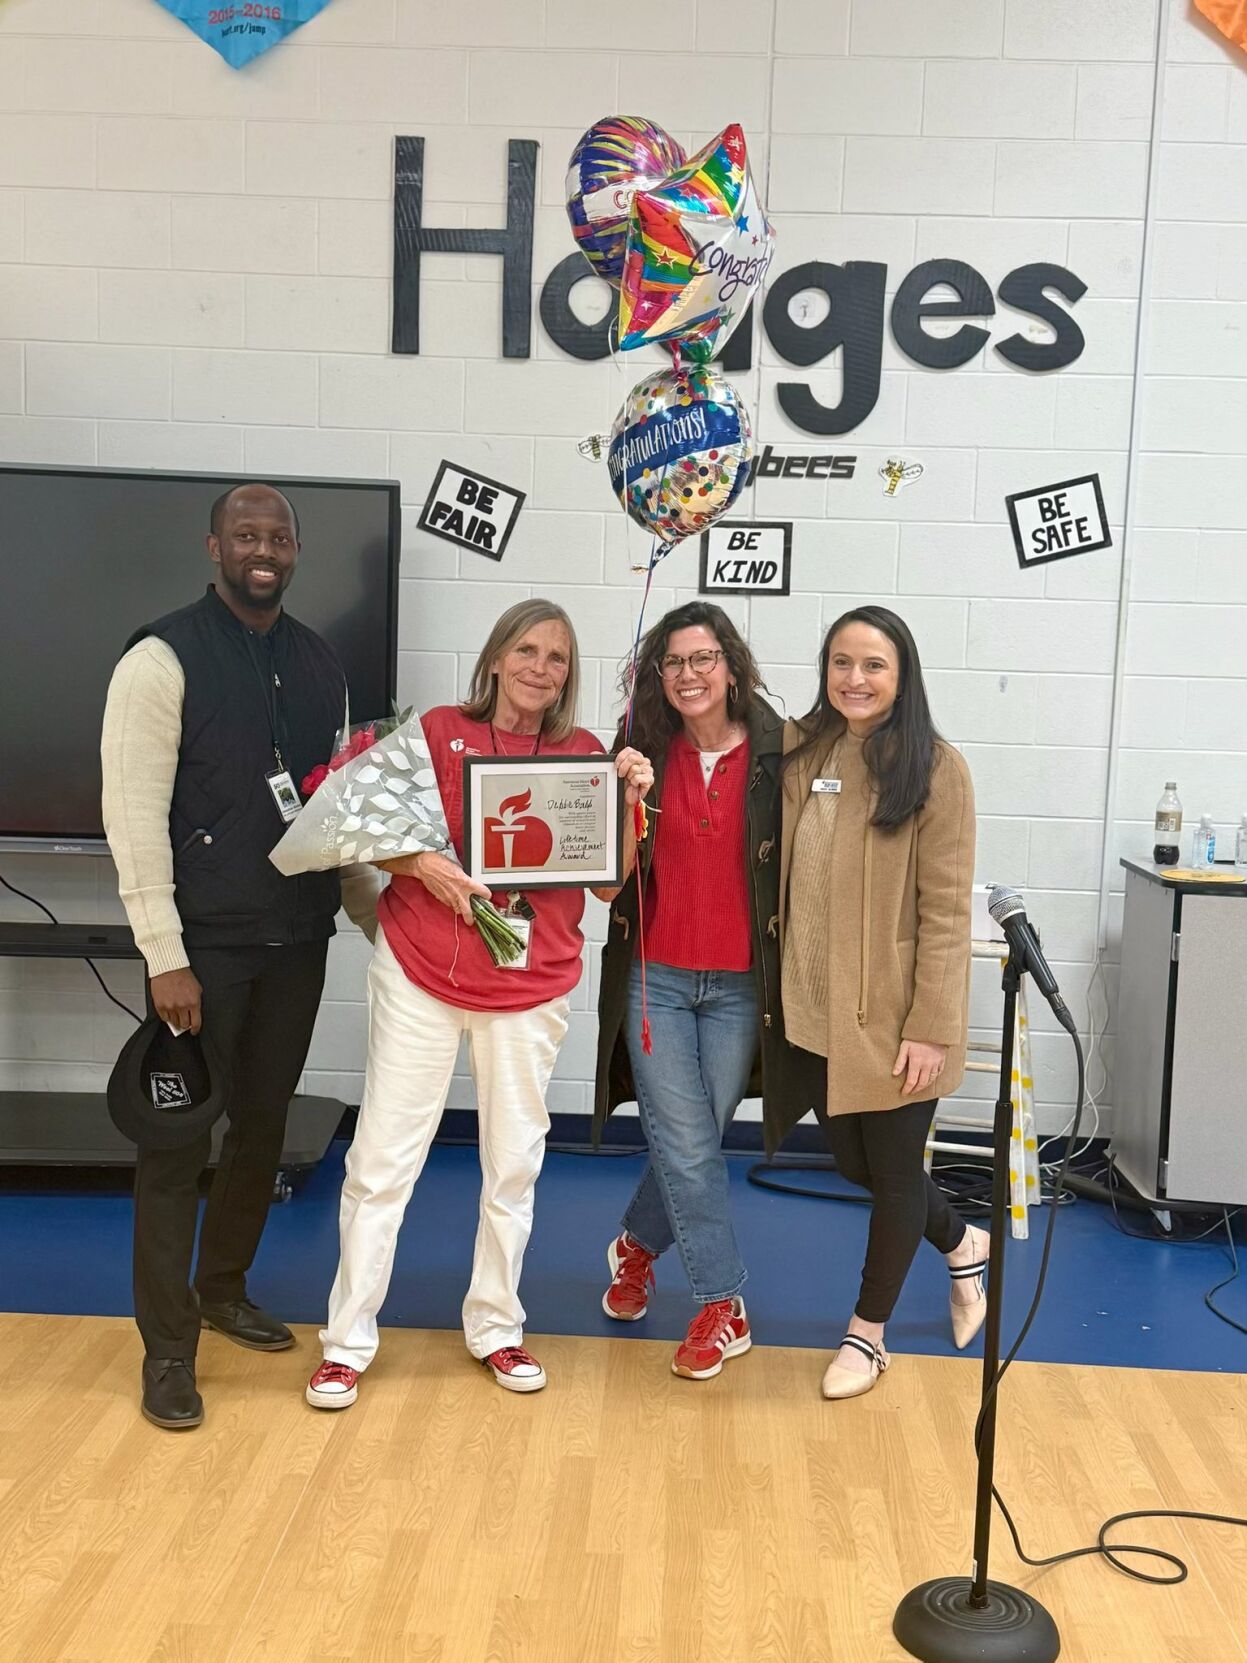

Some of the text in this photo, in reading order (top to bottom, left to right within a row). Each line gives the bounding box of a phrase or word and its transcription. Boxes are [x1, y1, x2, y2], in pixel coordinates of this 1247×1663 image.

[392, 135, 1088, 435] Hoges
[456, 478, 499, 515] BE
[1038, 492, 1071, 523] BE
[428, 501, 497, 549] FAIR
[727, 531, 762, 550] BE
[1031, 516, 1092, 554] SAFE
[712, 560, 778, 584] KIND
